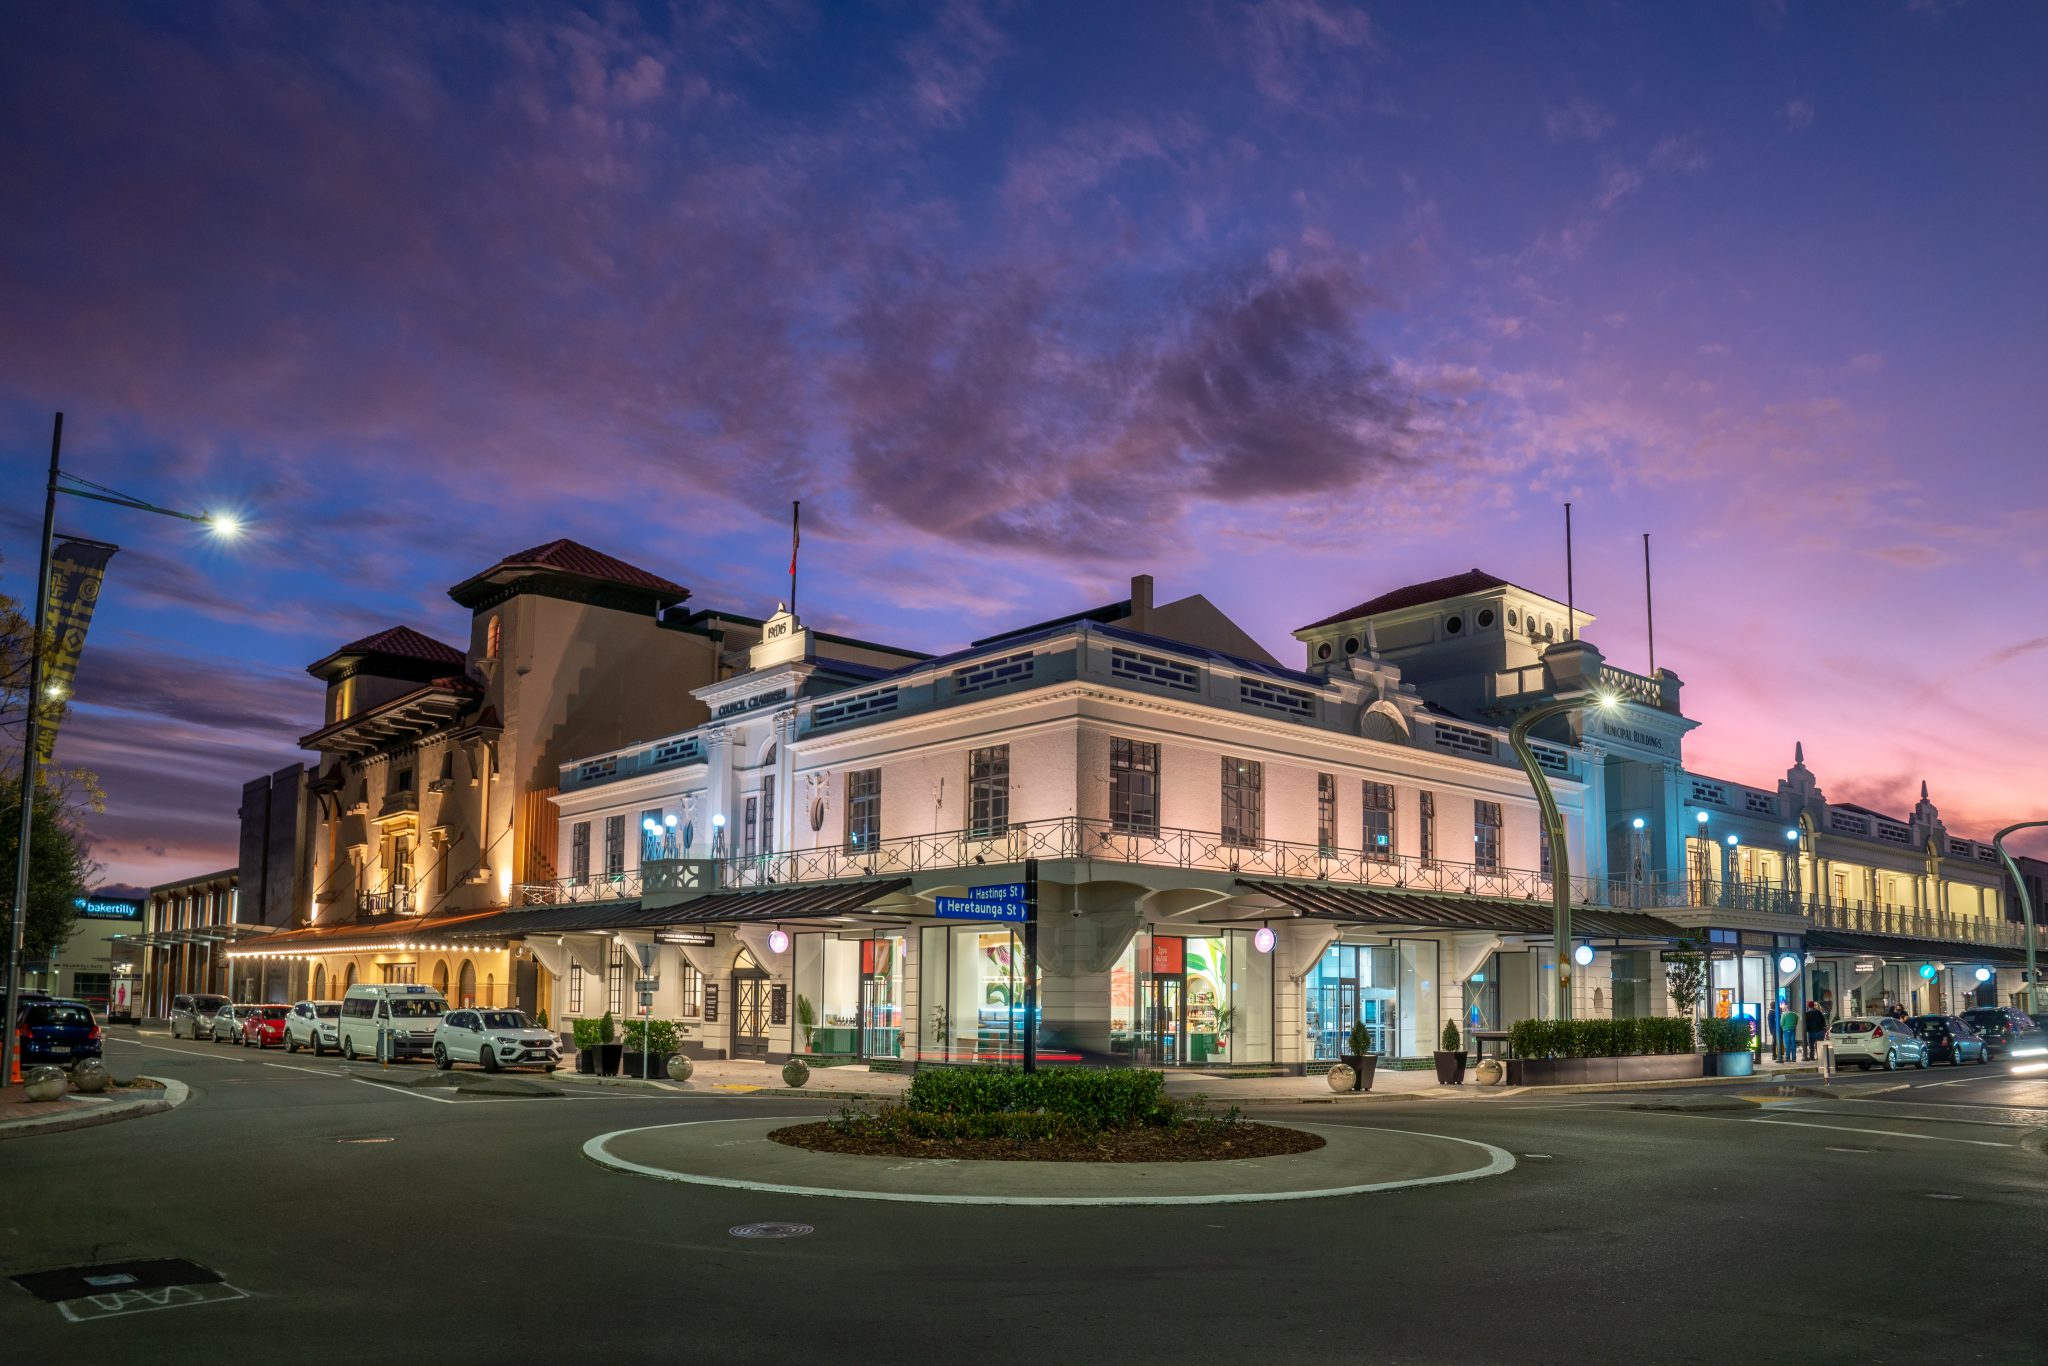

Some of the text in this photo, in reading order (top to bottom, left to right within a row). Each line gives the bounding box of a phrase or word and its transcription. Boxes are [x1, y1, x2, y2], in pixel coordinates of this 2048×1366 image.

[718, 698, 747, 715] COUNCIL
[1603, 722, 1632, 741] MUNICIPAL
[975, 885, 1018, 901] Hastings St
[87, 903, 135, 916] bakertilly
[947, 900, 1017, 918] Heretaunga St
